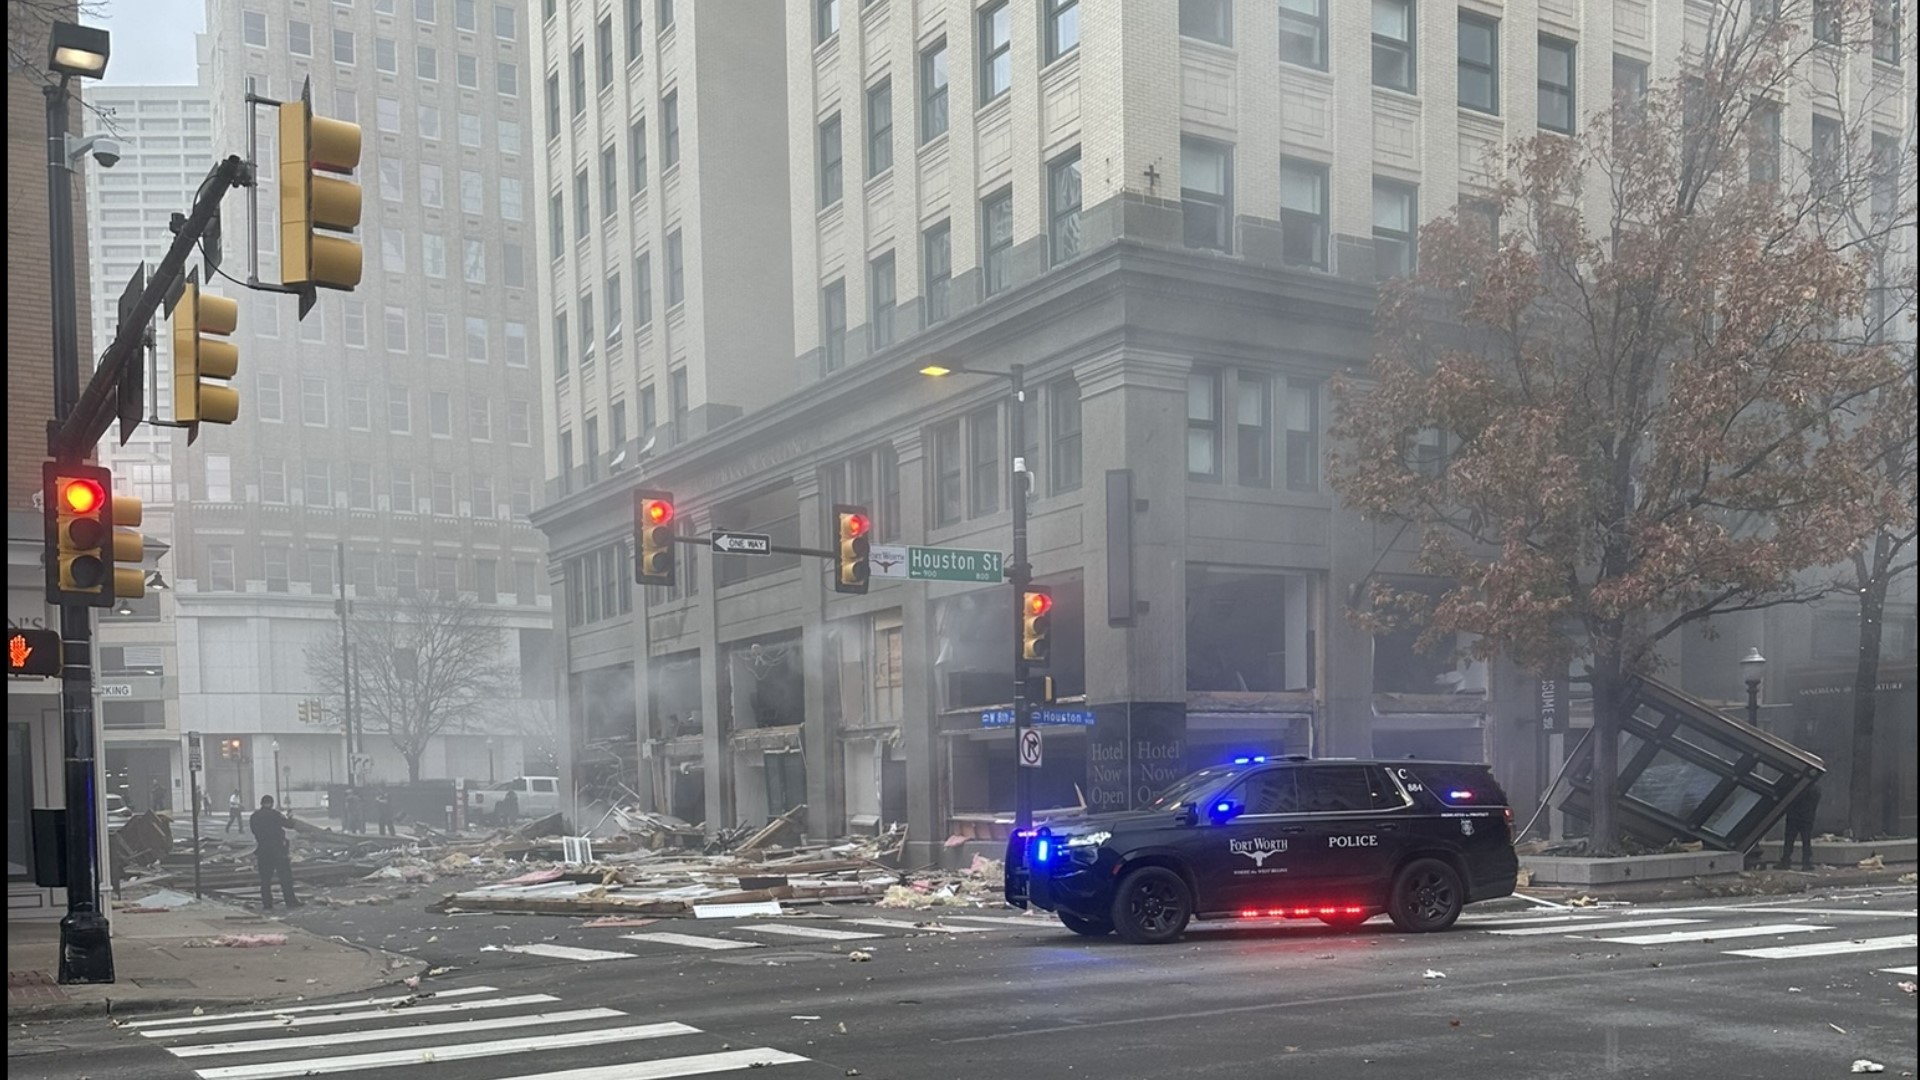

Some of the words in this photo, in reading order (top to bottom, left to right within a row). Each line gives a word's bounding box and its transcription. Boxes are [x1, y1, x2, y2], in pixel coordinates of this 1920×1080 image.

[728, 537, 745, 548] ONE
[747, 539, 764, 549] WAY
[912, 549, 975, 571] Houston
[983, 553, 999, 572] St
[923, 570, 937, 578] 900
[101, 686, 129, 696] RKING
[1043, 711, 1082, 723] Houston
[1092, 741, 1124, 761] Hotel
[1137, 741, 1180, 759] Hotel
[1094, 765, 1122, 782] Now
[1140, 763, 1178, 781] Now
[1397, 768, 1408, 780] C
[1091, 786, 1124, 809] Open
[1230, 839, 1252, 850] FORT
[1253, 837, 1288, 850] WORTH
[1328, 835, 1378, 848] POLICE
